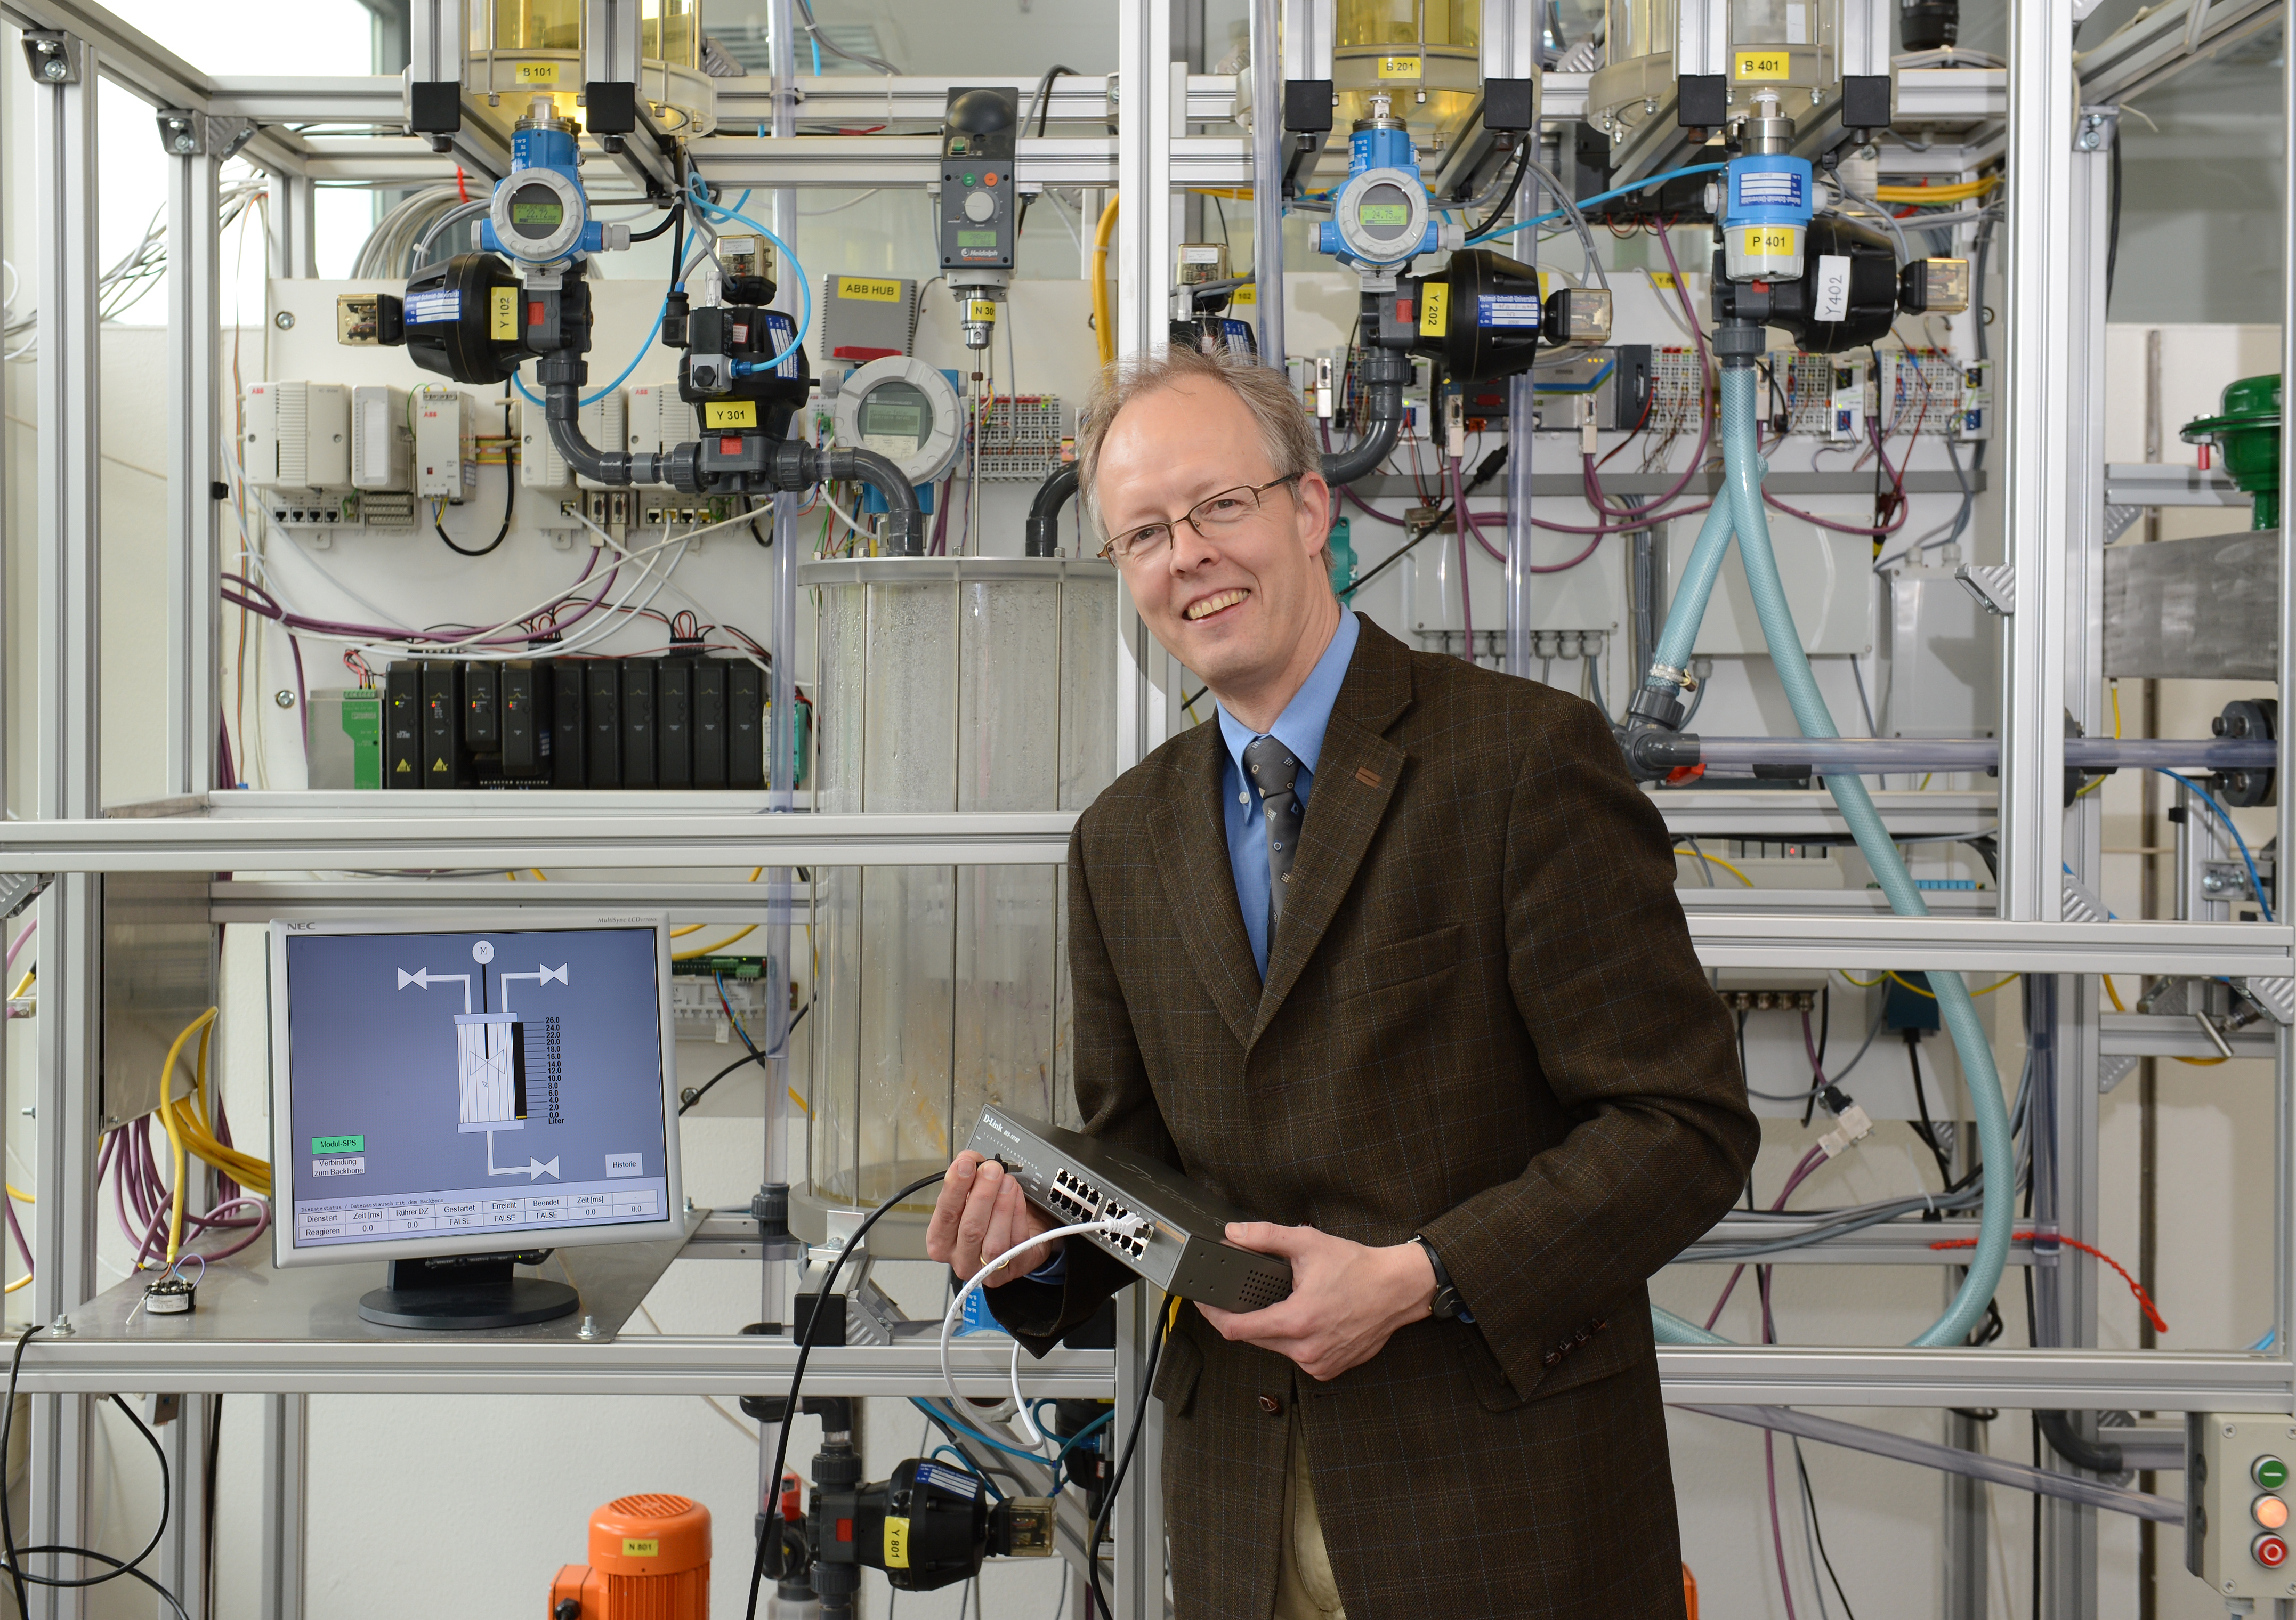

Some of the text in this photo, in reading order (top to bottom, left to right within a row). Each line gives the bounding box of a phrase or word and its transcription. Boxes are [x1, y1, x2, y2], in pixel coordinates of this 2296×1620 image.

[1387, 62, 1413, 71] B 201
[1745, 60, 1779, 71] B 401
[523, 68, 551, 76] B 101
[1753, 236, 1785, 247] P 401
[846, 284, 894, 296] ABB HUB
[500, 297, 510, 318] 102
[1428, 306, 1438, 326] 202
[717, 410, 745, 420] Y 301
[287, 922, 316, 930] NEC
[983, 1114, 1003, 1132] D-Link
[320, 1139, 357, 1148] Modul-SPS
[591, 1196, 604, 1204] [ms]
[444, 1204, 475, 1213] Gestartet
[353, 1210, 383, 1220] Zeit [ms]
[305, 1227, 341, 1236] Reagieren
[891, 1540, 900, 1558] 801
